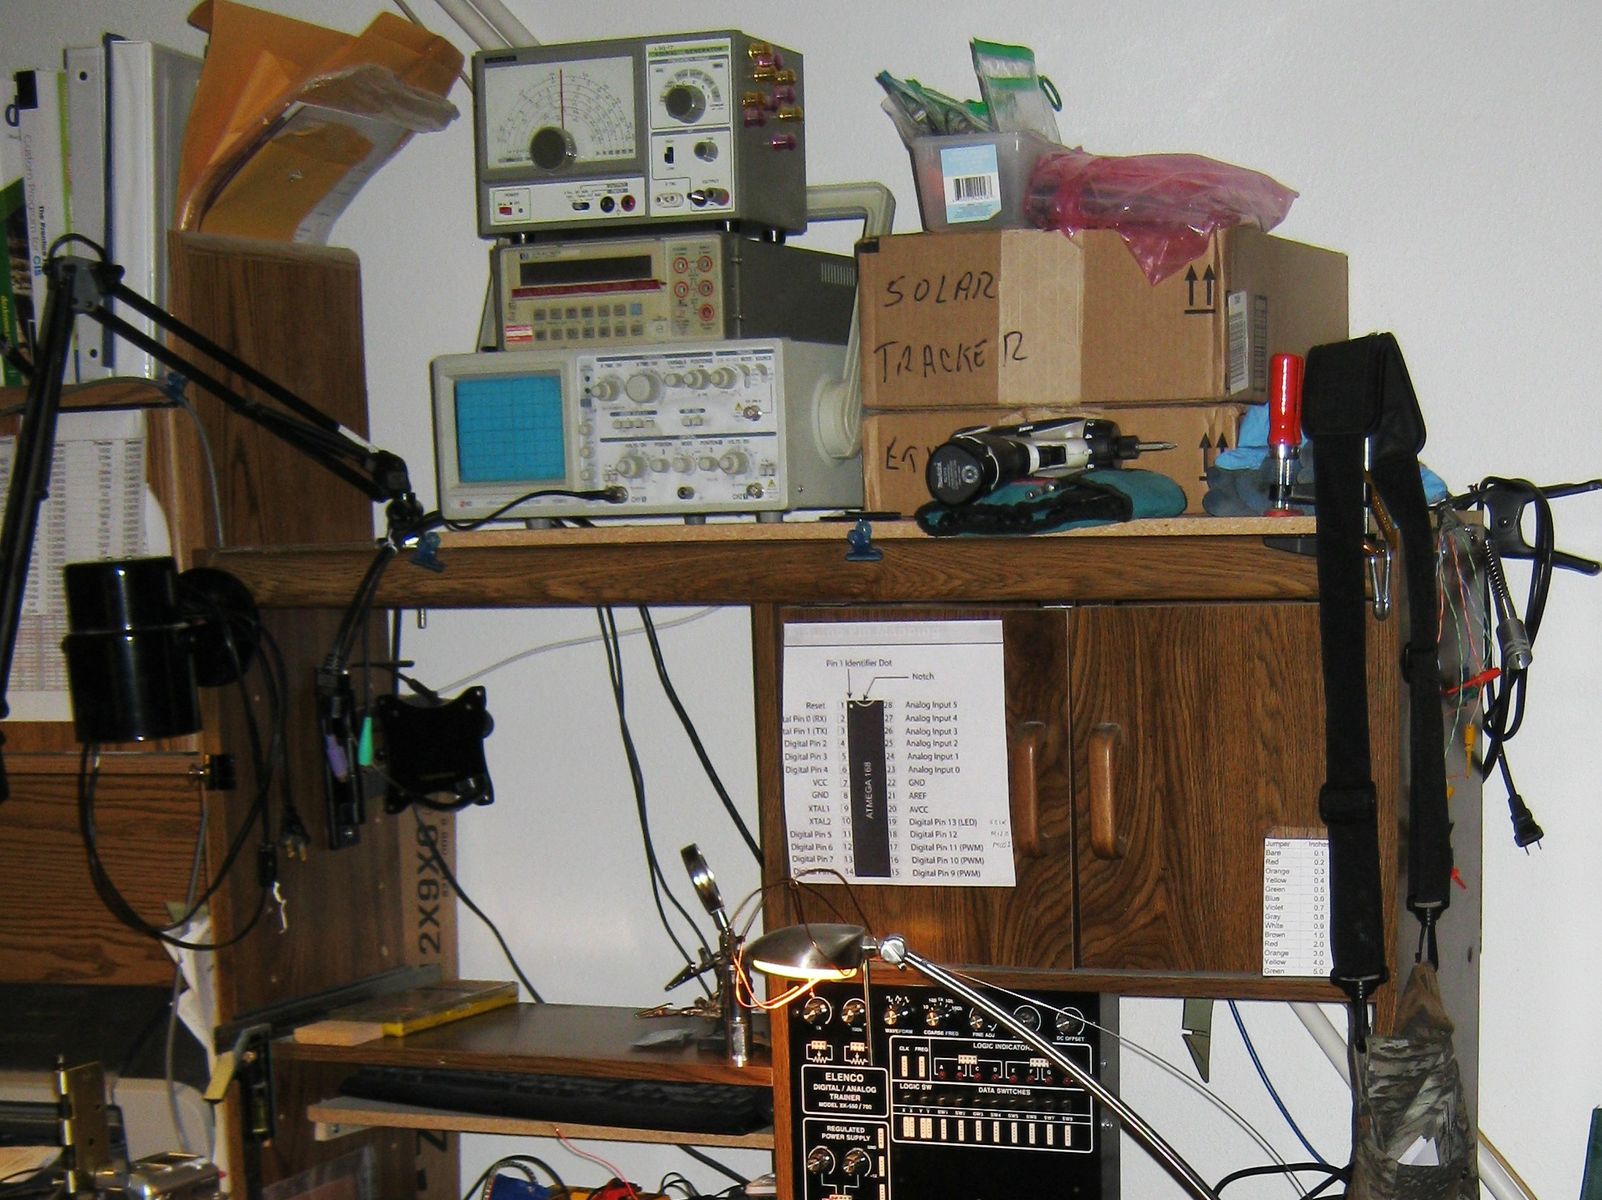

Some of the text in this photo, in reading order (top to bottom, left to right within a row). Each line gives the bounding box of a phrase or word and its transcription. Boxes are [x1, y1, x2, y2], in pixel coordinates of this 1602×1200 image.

[884, 271, 996, 307] SOLAR
[873, 331, 1028, 383] TRACKER
[826, 658, 892, 667] Pin Identifier Dot
[912, 672, 934, 680] Notch
[905, 701, 951, 710] Analog Input
[905, 714, 930, 723] Analog
[932, 714, 951, 723] Input
[793, 727, 827, 735] Pin (TX)
[905, 728, 930, 736] Analog
[932, 728, 951, 736] Input
[784, 740, 808, 748] Digital
[906, 740, 931, 749] Analog
[933, 740, 952, 748] Input
[785, 753, 808, 761] Digital
[907, 753, 932, 761] Analog
[934, 753, 953, 762] Input
[785, 766, 809, 775] Digital
[908, 766, 933, 775] Analog
[934, 766, 953, 774] Input
[908, 779, 925, 787] GND
[812, 791, 829, 799] GND
[863, 761, 873, 820] ATMEGA 168
[908, 792, 927, 800] AREF
[808, 805, 830, 813] XTAL1
[909, 806, 929, 814] AVCC
[909, 818, 933, 827] Digital
[934, 818, 946, 826] Pin
[948, 818, 957, 826] 13
[958, 818, 977, 827] (LED)
[790, 831, 813, 839] Digital
[910, 831, 934, 839] Digital
[949, 831, 958, 839] 12
[791, 843, 814, 852] Digital
[910, 843, 935, 852] Digital
[936, 843, 948, 851] Pin
[960, 844, 984, 852] (PWM)
[1265, 841, 1290, 849] Jumper
[792, 856, 815, 864] Digital
[911, 856, 936, 865] Digital
[937, 856, 948, 864] Pin
[950, 856, 959, 864] 10
[960, 856, 985, 865] (PWM)
[912, 868, 936, 877] Digital
[937, 868, 949, 876] Pin
[957, 869, 981, 877] (PWM)
[973, 1042, 1034, 1051] LOGIC INDICATOR
[825, 1072, 864, 1082] ELENCO
[813, 1083, 877, 1093] DIGITAL ANALOG
[829, 1093, 861, 1101] TRAINER
[826, 1125, 865, 1133] REGULATED
